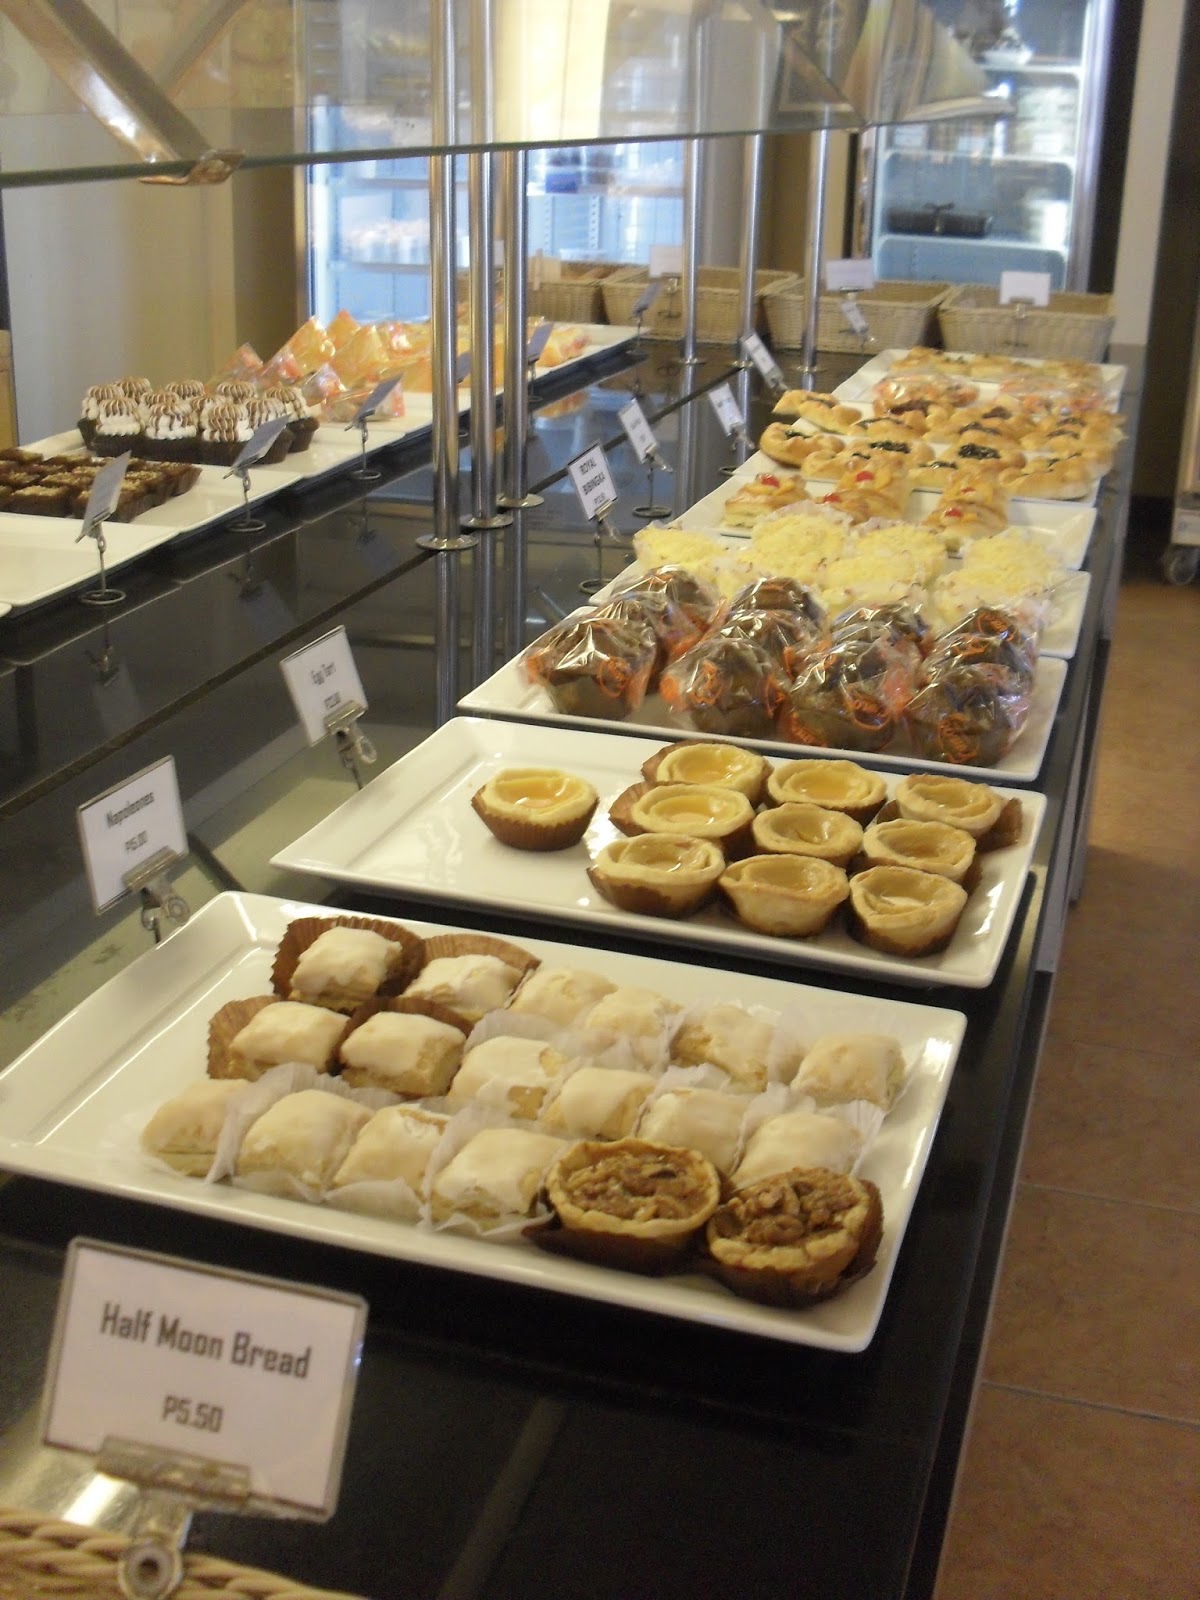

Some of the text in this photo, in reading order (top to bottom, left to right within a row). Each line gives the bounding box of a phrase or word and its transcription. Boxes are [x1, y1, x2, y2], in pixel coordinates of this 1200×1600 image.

[99, 1301, 312, 1379] Half Moon Bread
[161, 1395, 224, 1434] P5.50
